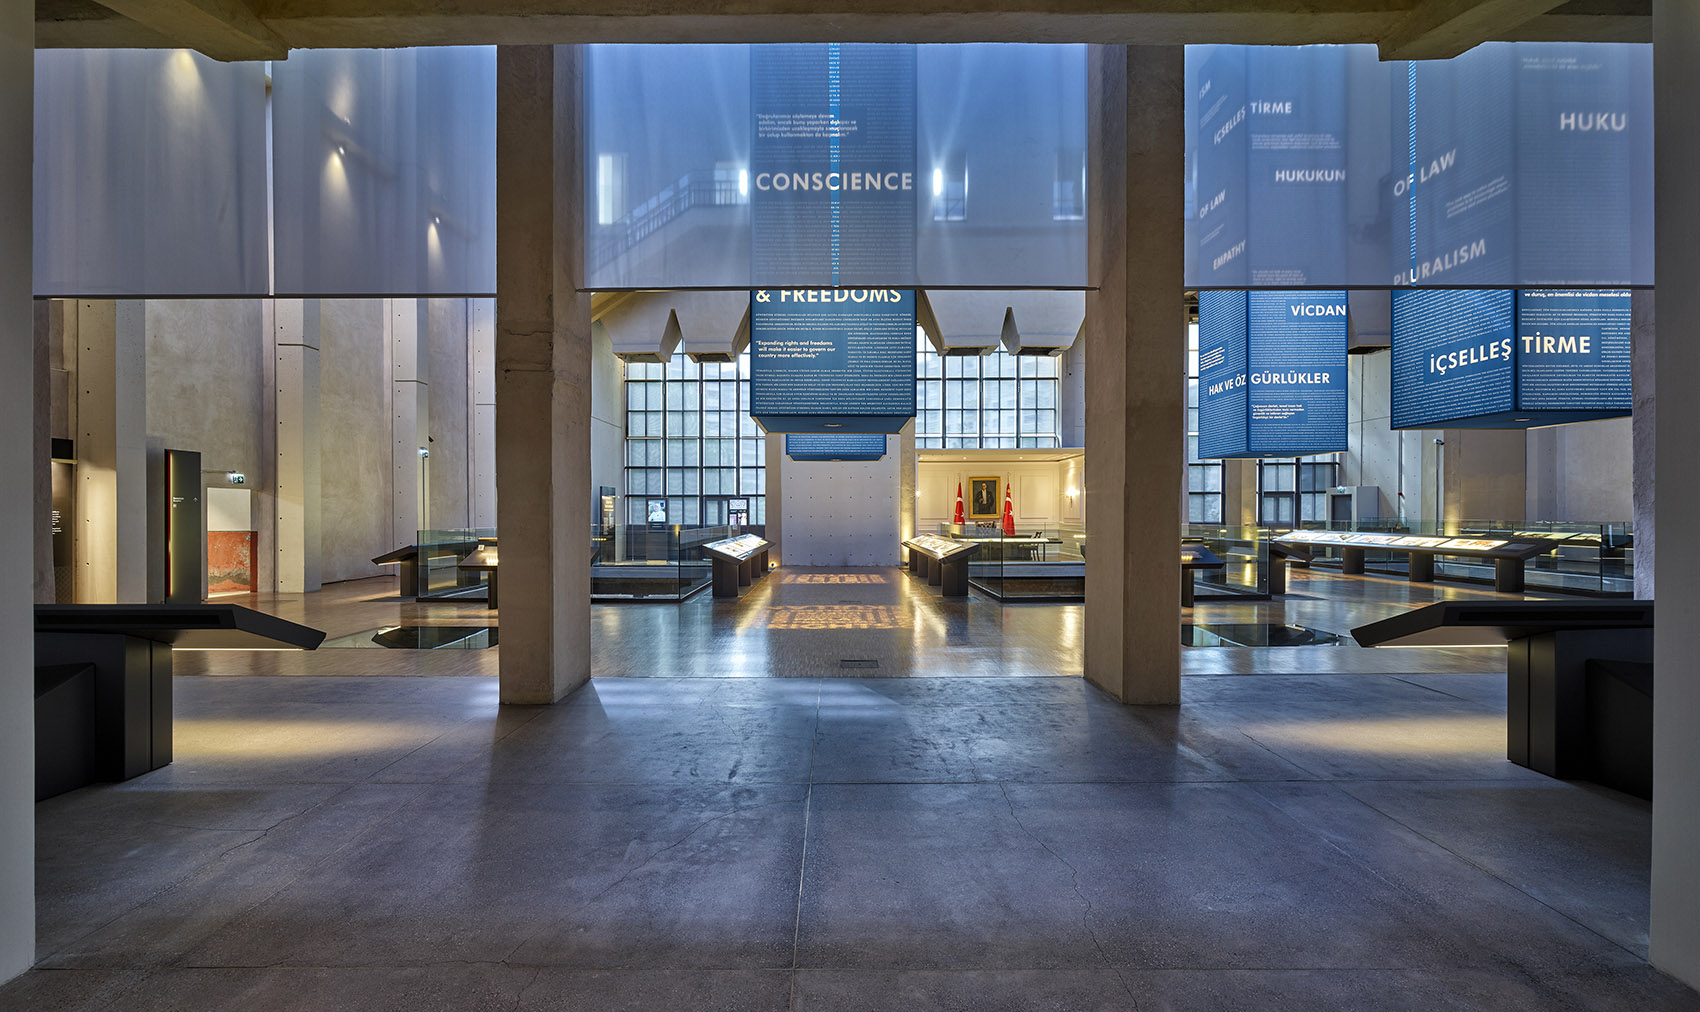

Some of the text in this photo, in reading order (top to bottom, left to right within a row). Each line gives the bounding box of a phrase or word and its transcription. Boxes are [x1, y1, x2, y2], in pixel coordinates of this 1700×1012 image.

[1250, 100, 1292, 114] TİRME
[1213, 105, 1246, 145] İÇSELLEŞ
[1560, 112, 1627, 131] HUKU
[756, 172, 913, 191] CONSCIENCE
[1275, 169, 1346, 182] HUKUKUN
[1393, 147, 1456, 196] OF LAW
[1199, 188, 1226, 219] OF LAW
[1213, 239, 1247, 270] EMPATHY
[1393, 238, 1486, 285] PLURALISM
[755, 289, 902, 303] & FREEDOMS
[1290, 302, 1346, 316] VİCDAN
[1521, 332, 1591, 354] TİRME
[1430, 338, 1512, 375] İÇSELLEŞ
[1208, 373, 1247, 396] HAK VE ÖZ
[1250, 370, 1330, 384] GÜRLÜKLER
